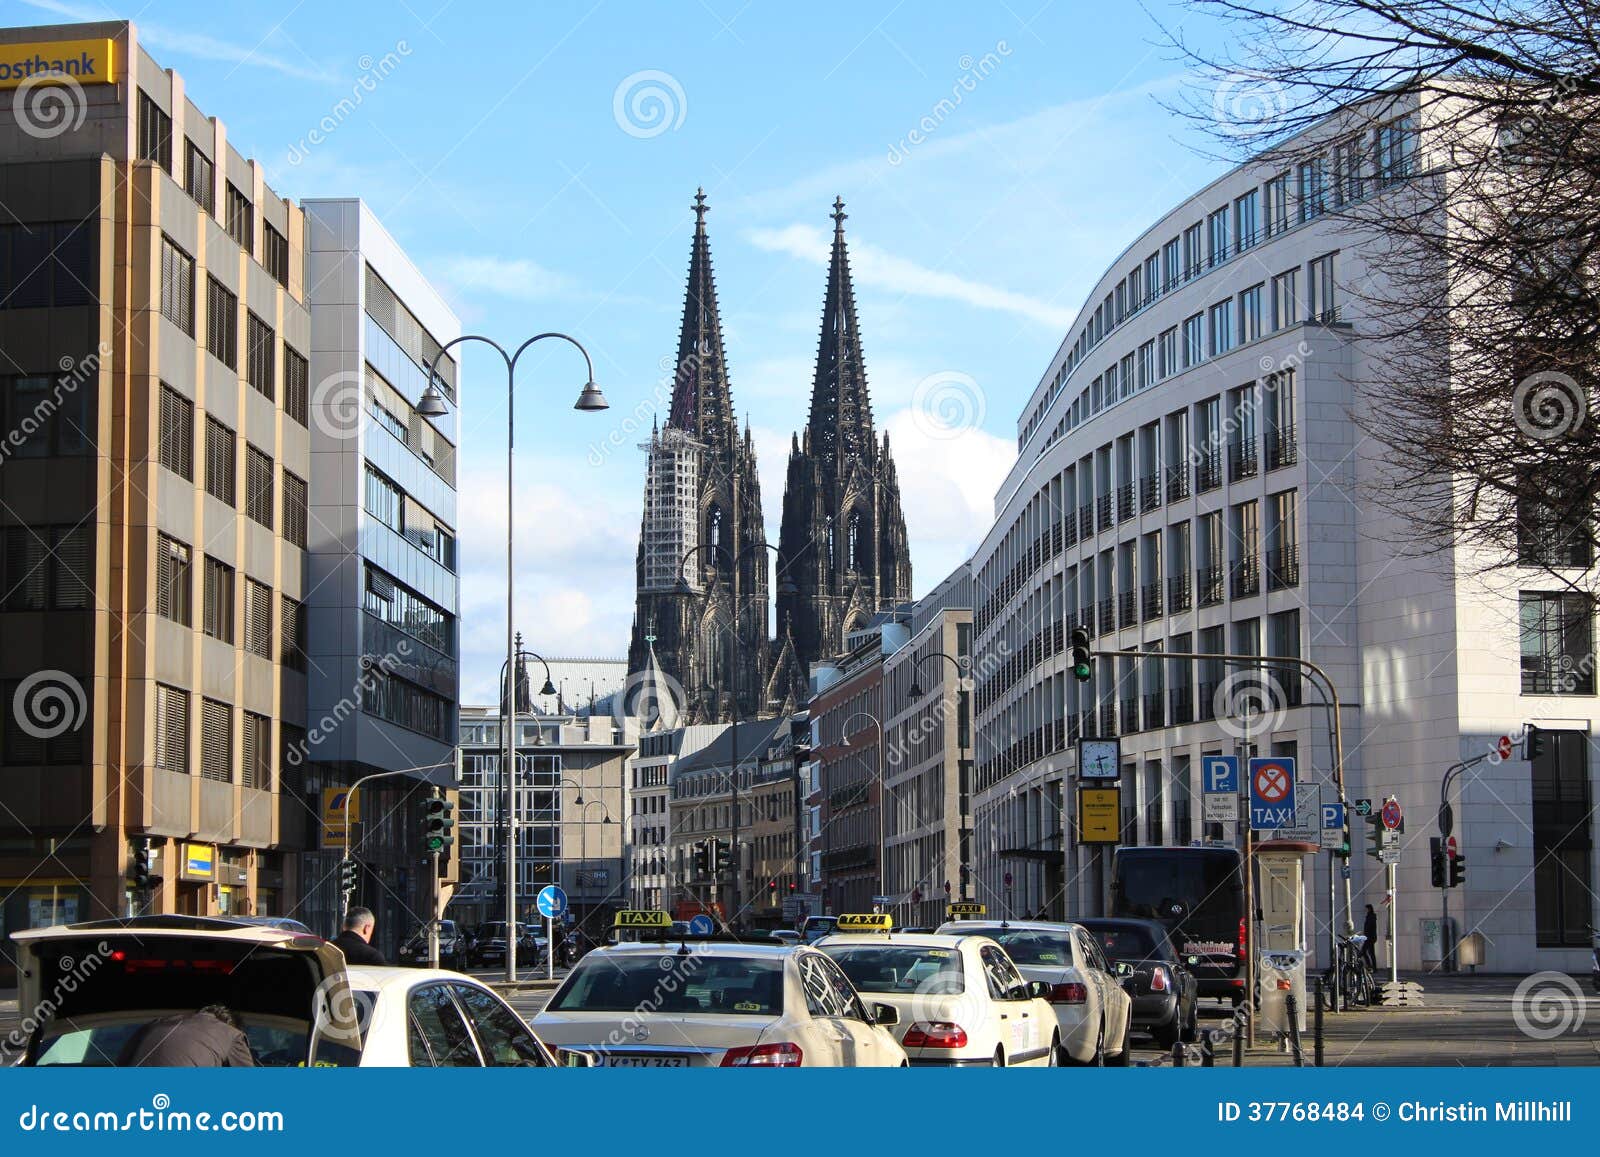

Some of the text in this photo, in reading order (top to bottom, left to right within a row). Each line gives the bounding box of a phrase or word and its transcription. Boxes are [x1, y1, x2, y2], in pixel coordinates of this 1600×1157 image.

[1211, 761, 1230, 790] P
[1253, 808, 1292, 823] TAXI
[1323, 807, 1337, 828] P
[622, 912, 660, 923] TAXI
[845, 915, 880, 924] TAXI
